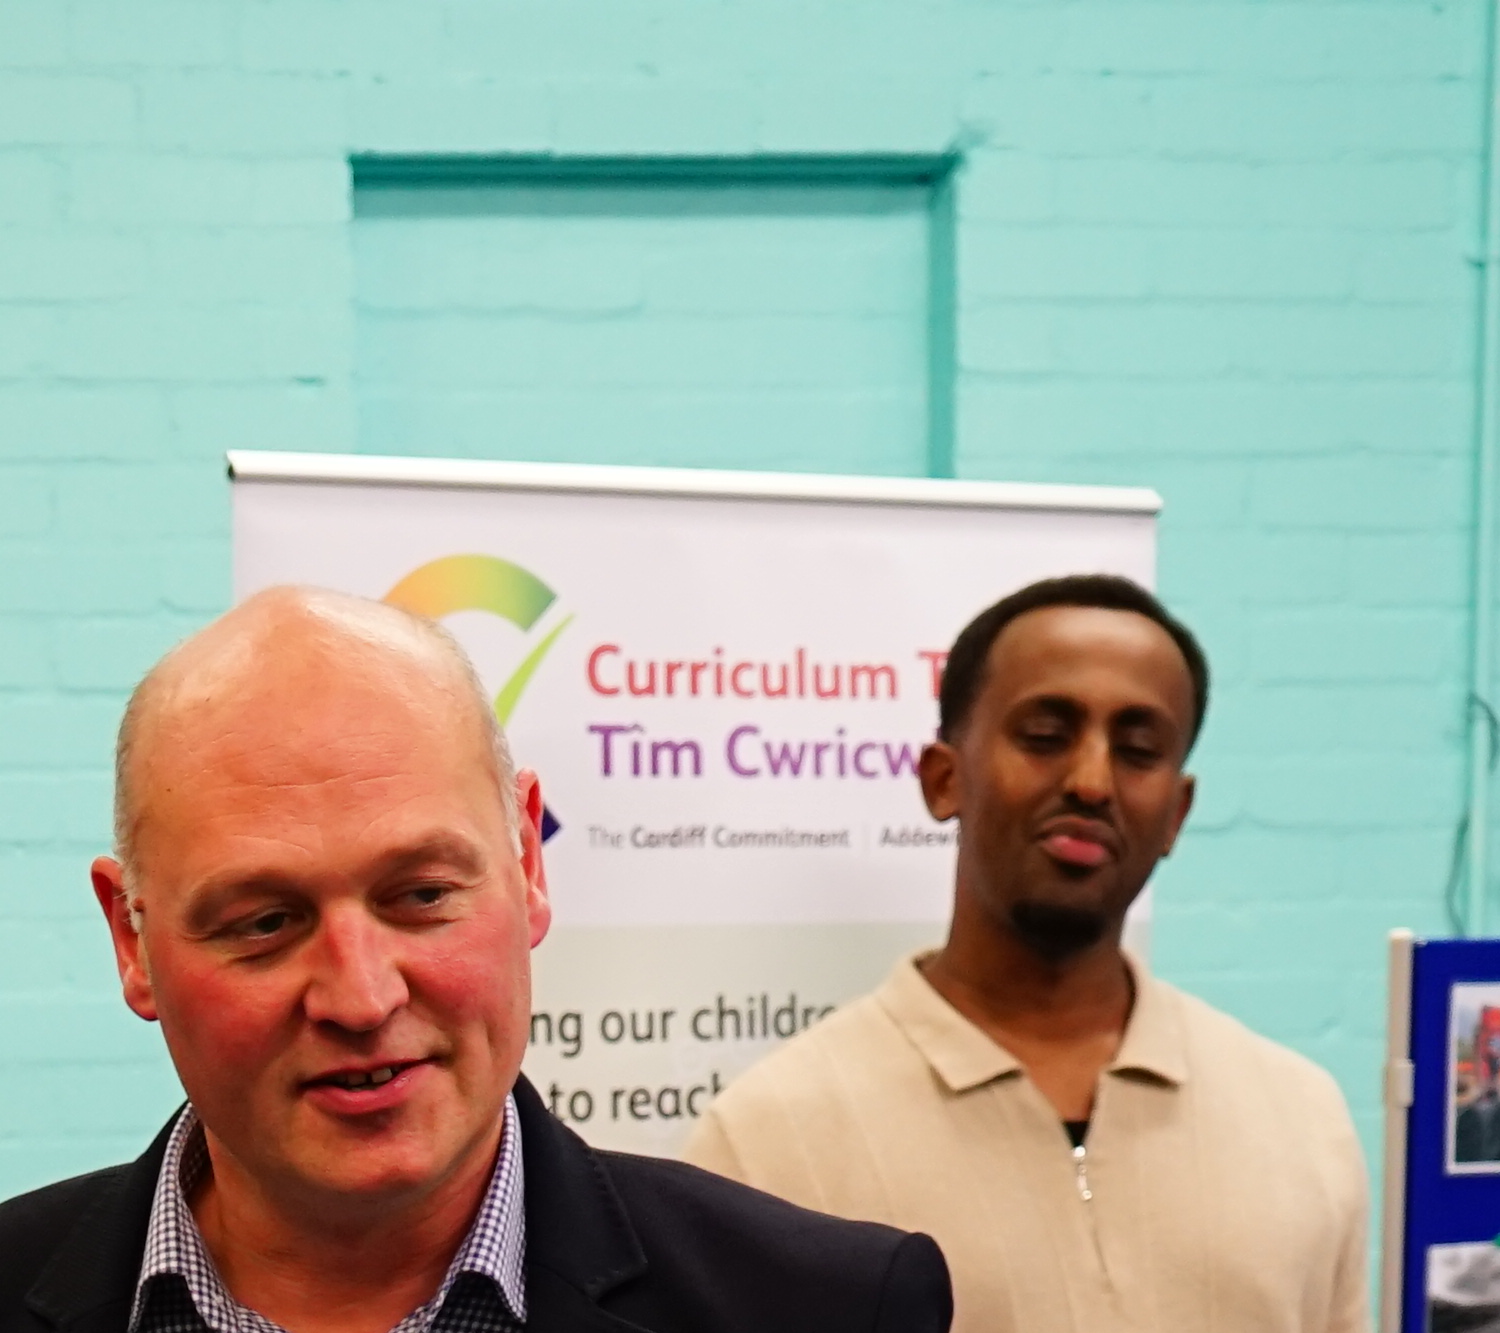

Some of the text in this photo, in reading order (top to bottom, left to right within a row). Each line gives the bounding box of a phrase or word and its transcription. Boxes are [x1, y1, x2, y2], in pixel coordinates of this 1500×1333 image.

[586, 644, 898, 700] Curriculum
[587, 722, 922, 778] Tîm Cwricw
[588, 825, 850, 849] The Cardiff Commitment
[529, 992, 836, 1058] ng our childr
[550, 1081, 593, 1123] to
